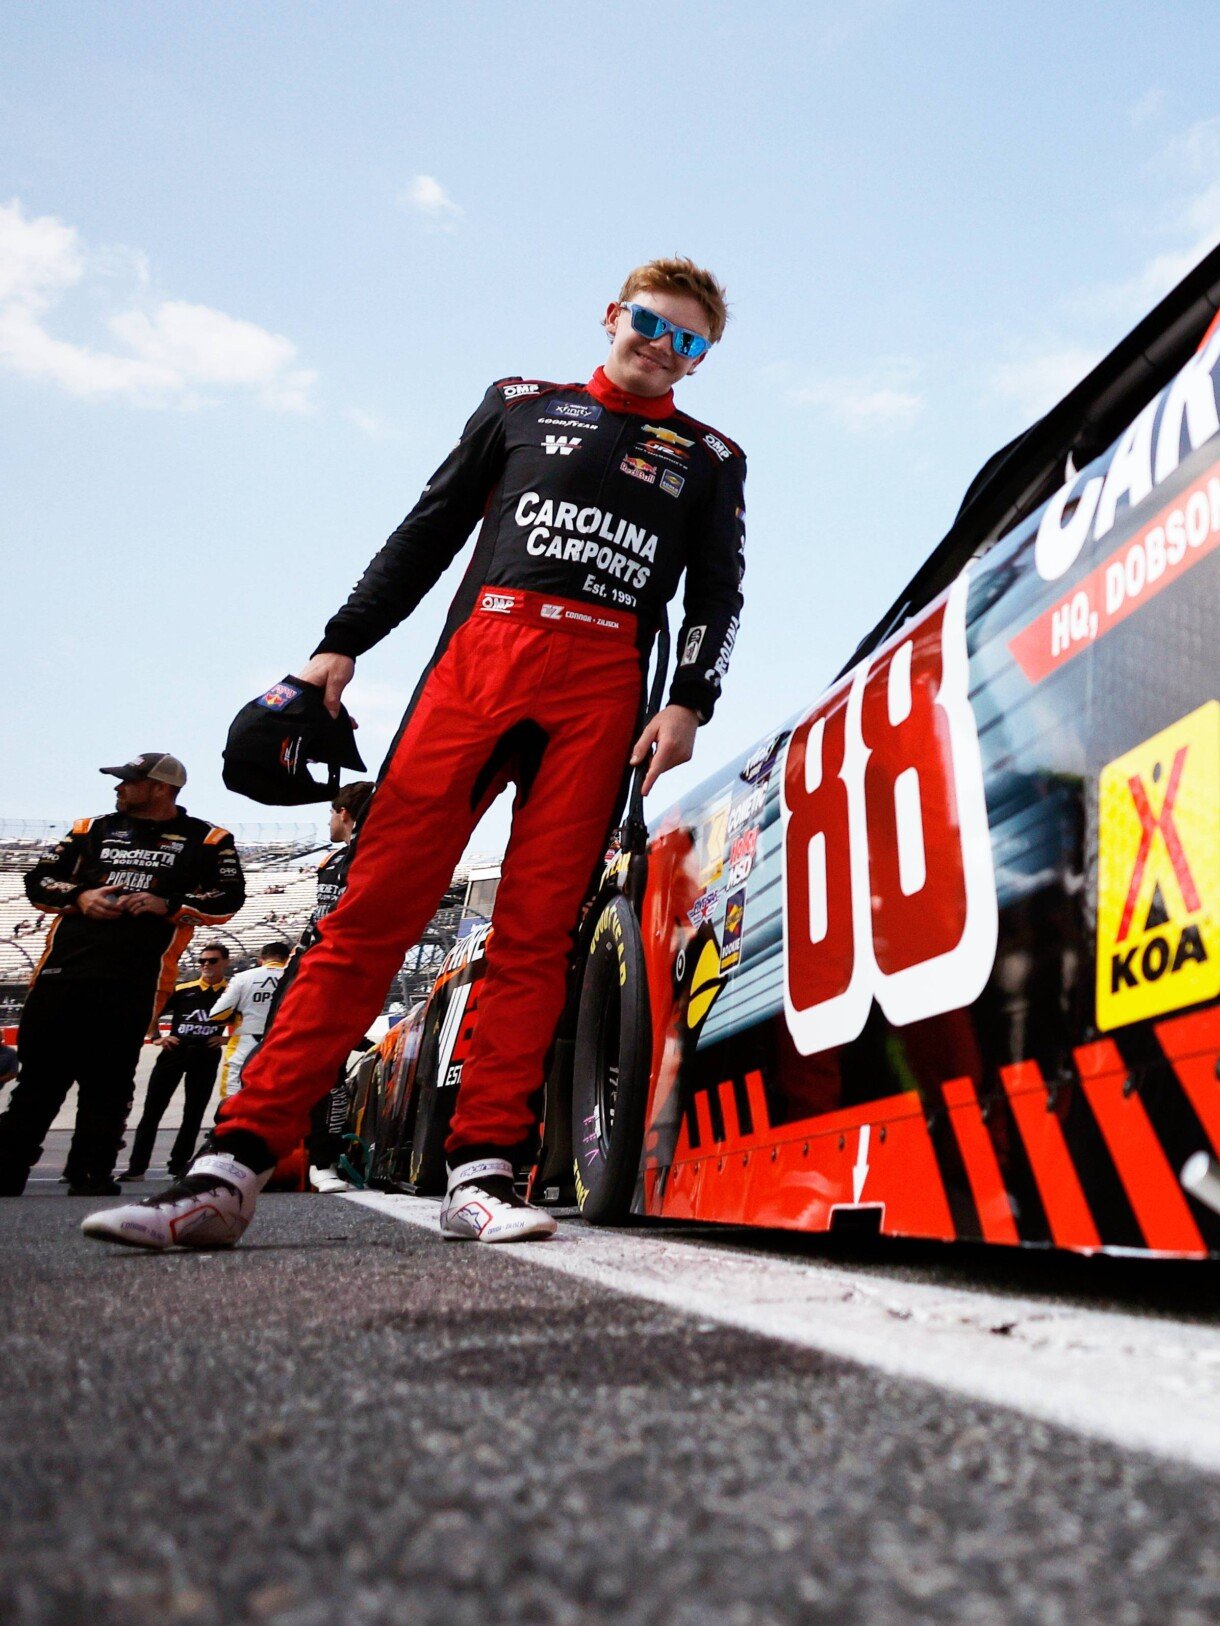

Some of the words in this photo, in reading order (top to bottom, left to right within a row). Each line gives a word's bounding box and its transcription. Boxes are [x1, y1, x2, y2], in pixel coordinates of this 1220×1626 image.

[503, 384, 540, 398] OMP
[556, 405, 592, 417] xfinity
[537, 417, 598, 430] GOODYEAR
[703, 433, 732, 461] OMP
[515, 491, 659, 563] CAROLINA
[526, 526, 651, 589] CARPORTS
[481, 593, 515, 613] OMP
[1051, 591, 1098, 657] HQ,
[780, 575, 998, 1056] 88
[100, 848, 176, 866] BORCHETTA
[113, 858, 160, 868] BOURBON
[105, 871, 153, 889] PICKERS
[1111, 924, 1208, 994] KOA
